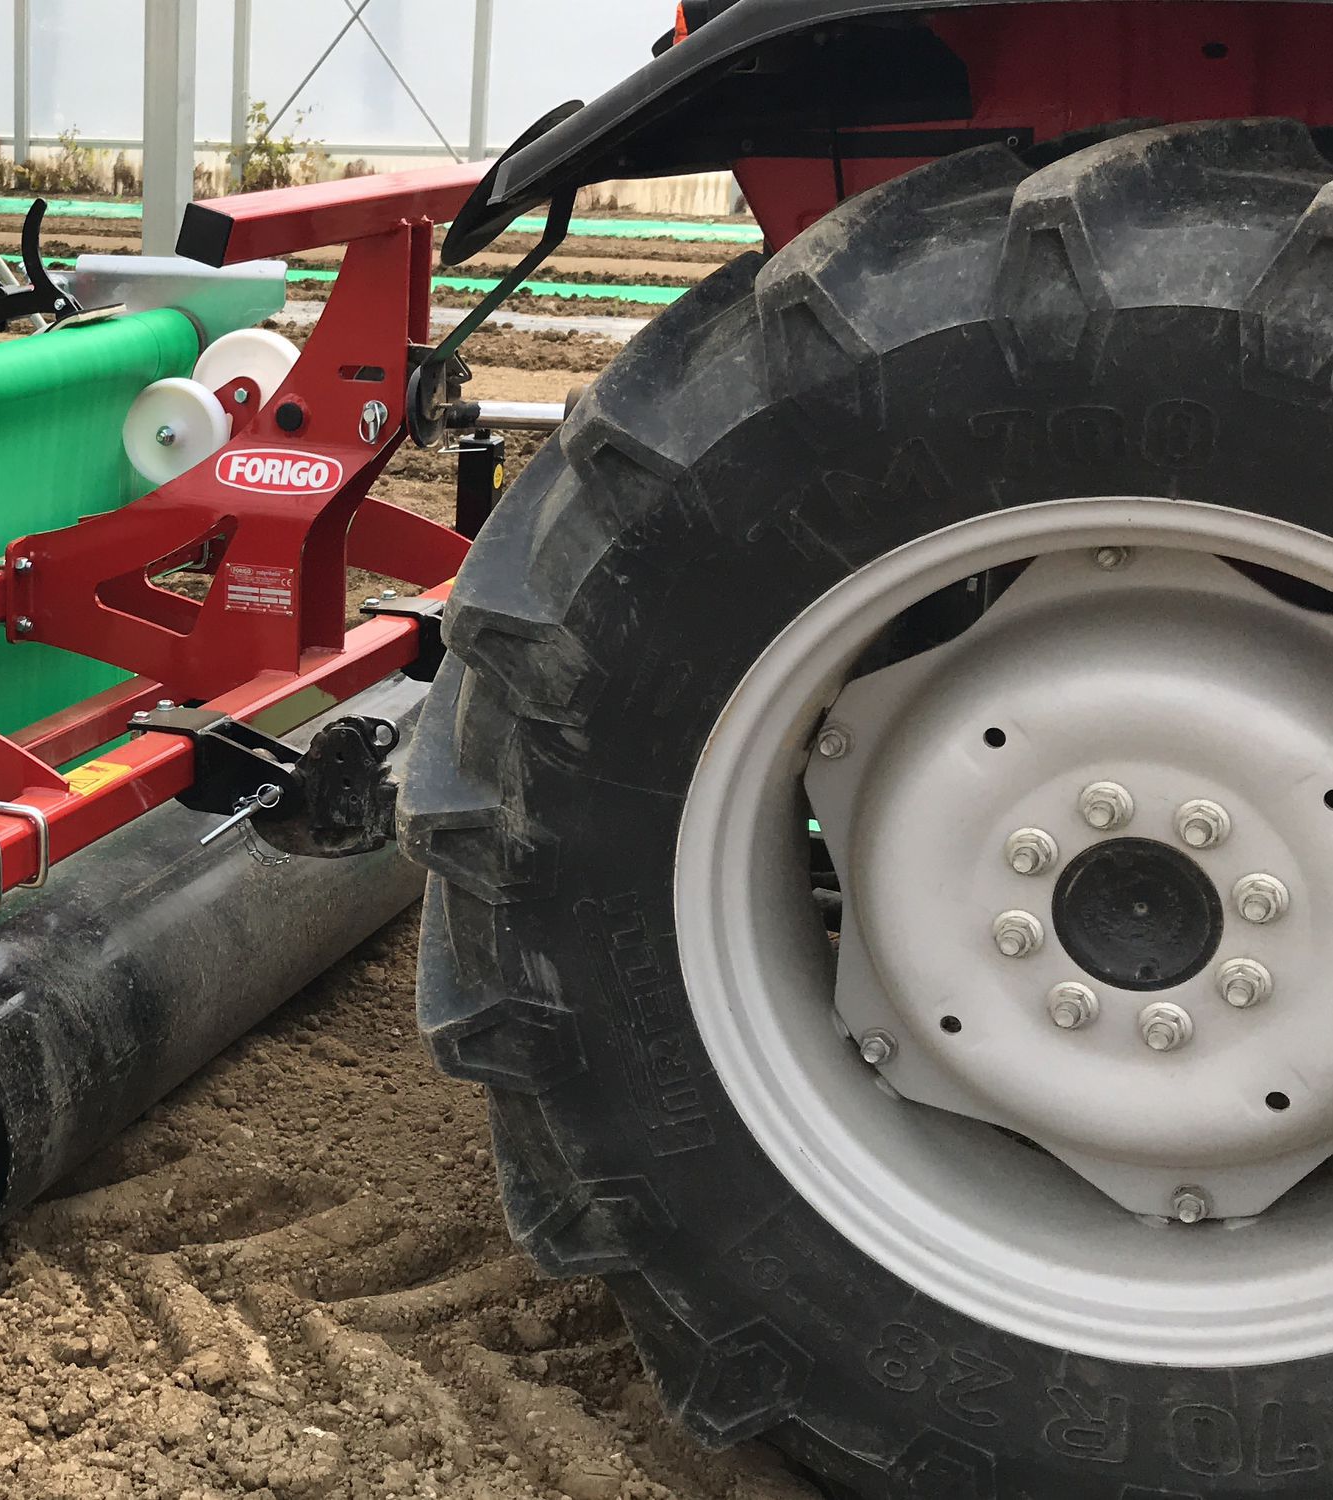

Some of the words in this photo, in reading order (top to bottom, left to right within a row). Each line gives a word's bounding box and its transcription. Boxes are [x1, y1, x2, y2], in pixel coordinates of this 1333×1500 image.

[228, 456, 329, 488] FORIGO
[865, 1321, 1016, 1428] 28
[1044, 1384, 1129, 1463] R
